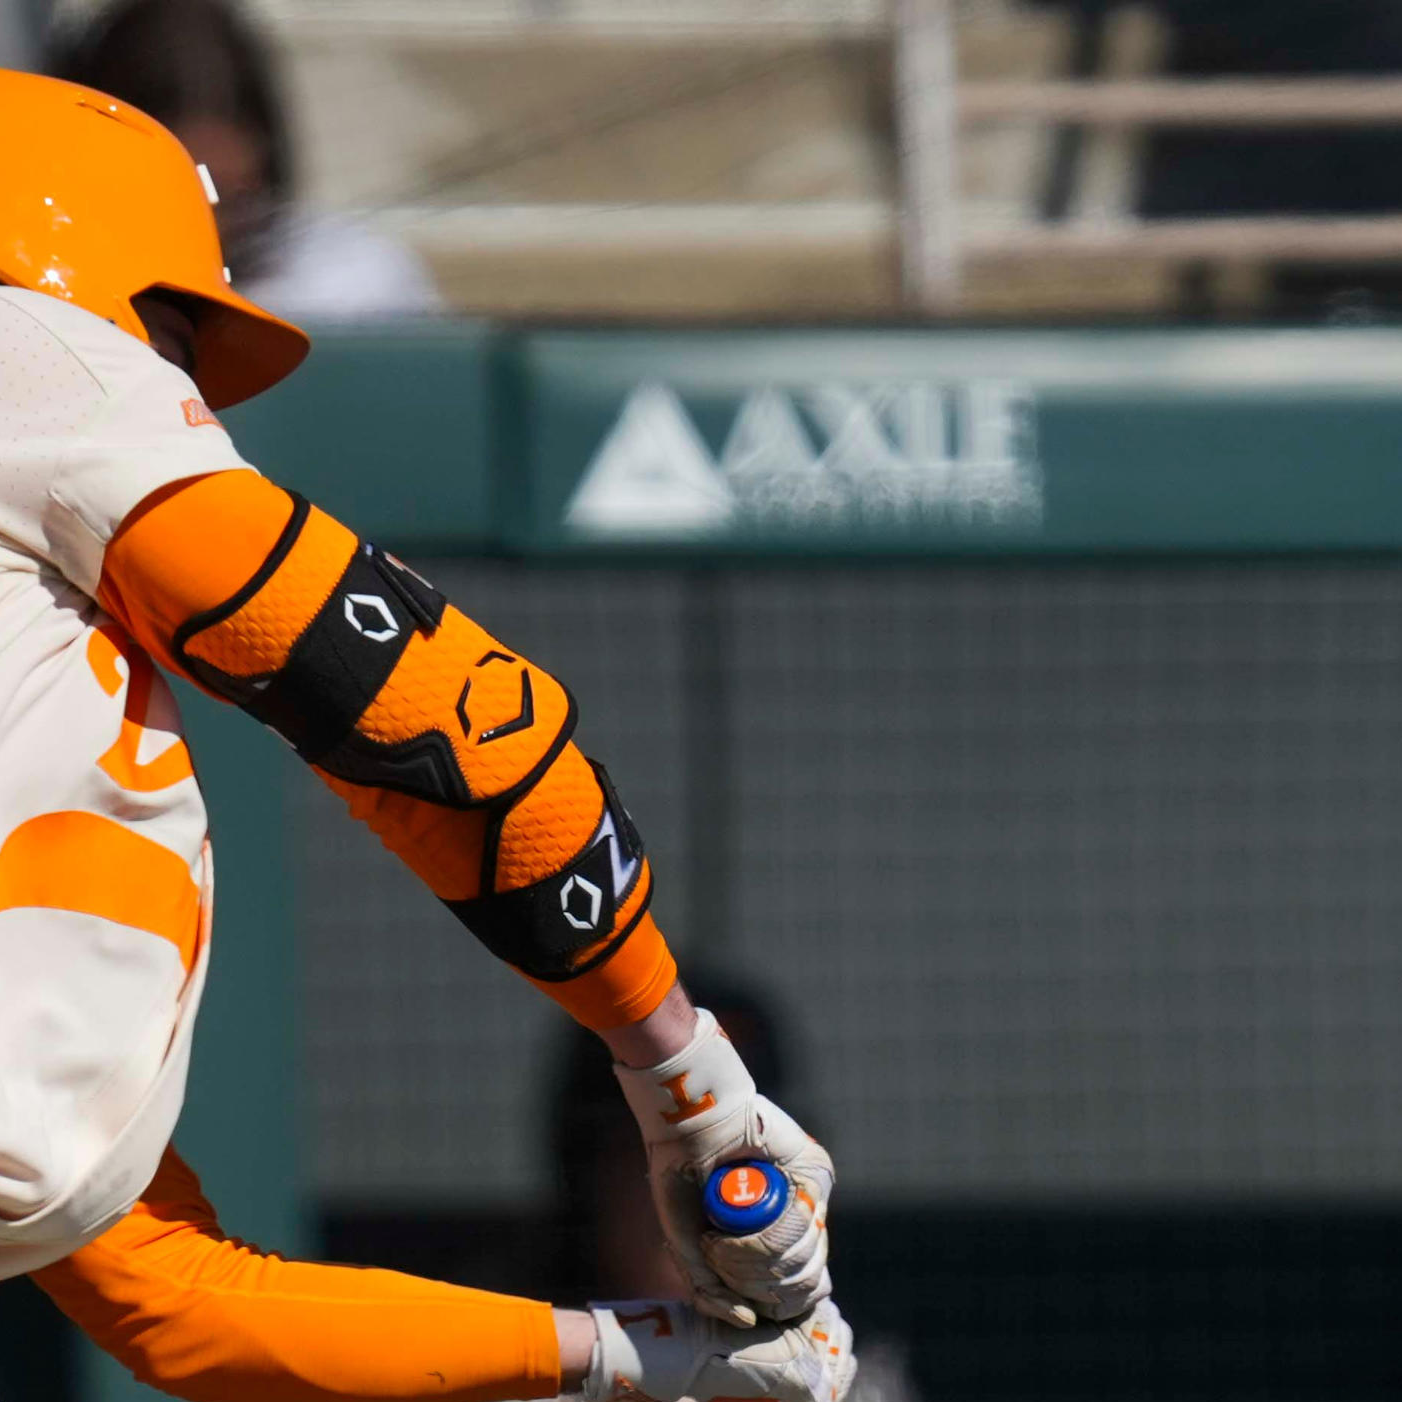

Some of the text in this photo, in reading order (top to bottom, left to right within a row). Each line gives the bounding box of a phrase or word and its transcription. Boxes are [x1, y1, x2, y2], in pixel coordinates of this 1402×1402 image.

[718, 376, 1034, 476] AXLE
[659, 1070, 718, 1125] T
[733, 1181, 756, 1203] T
